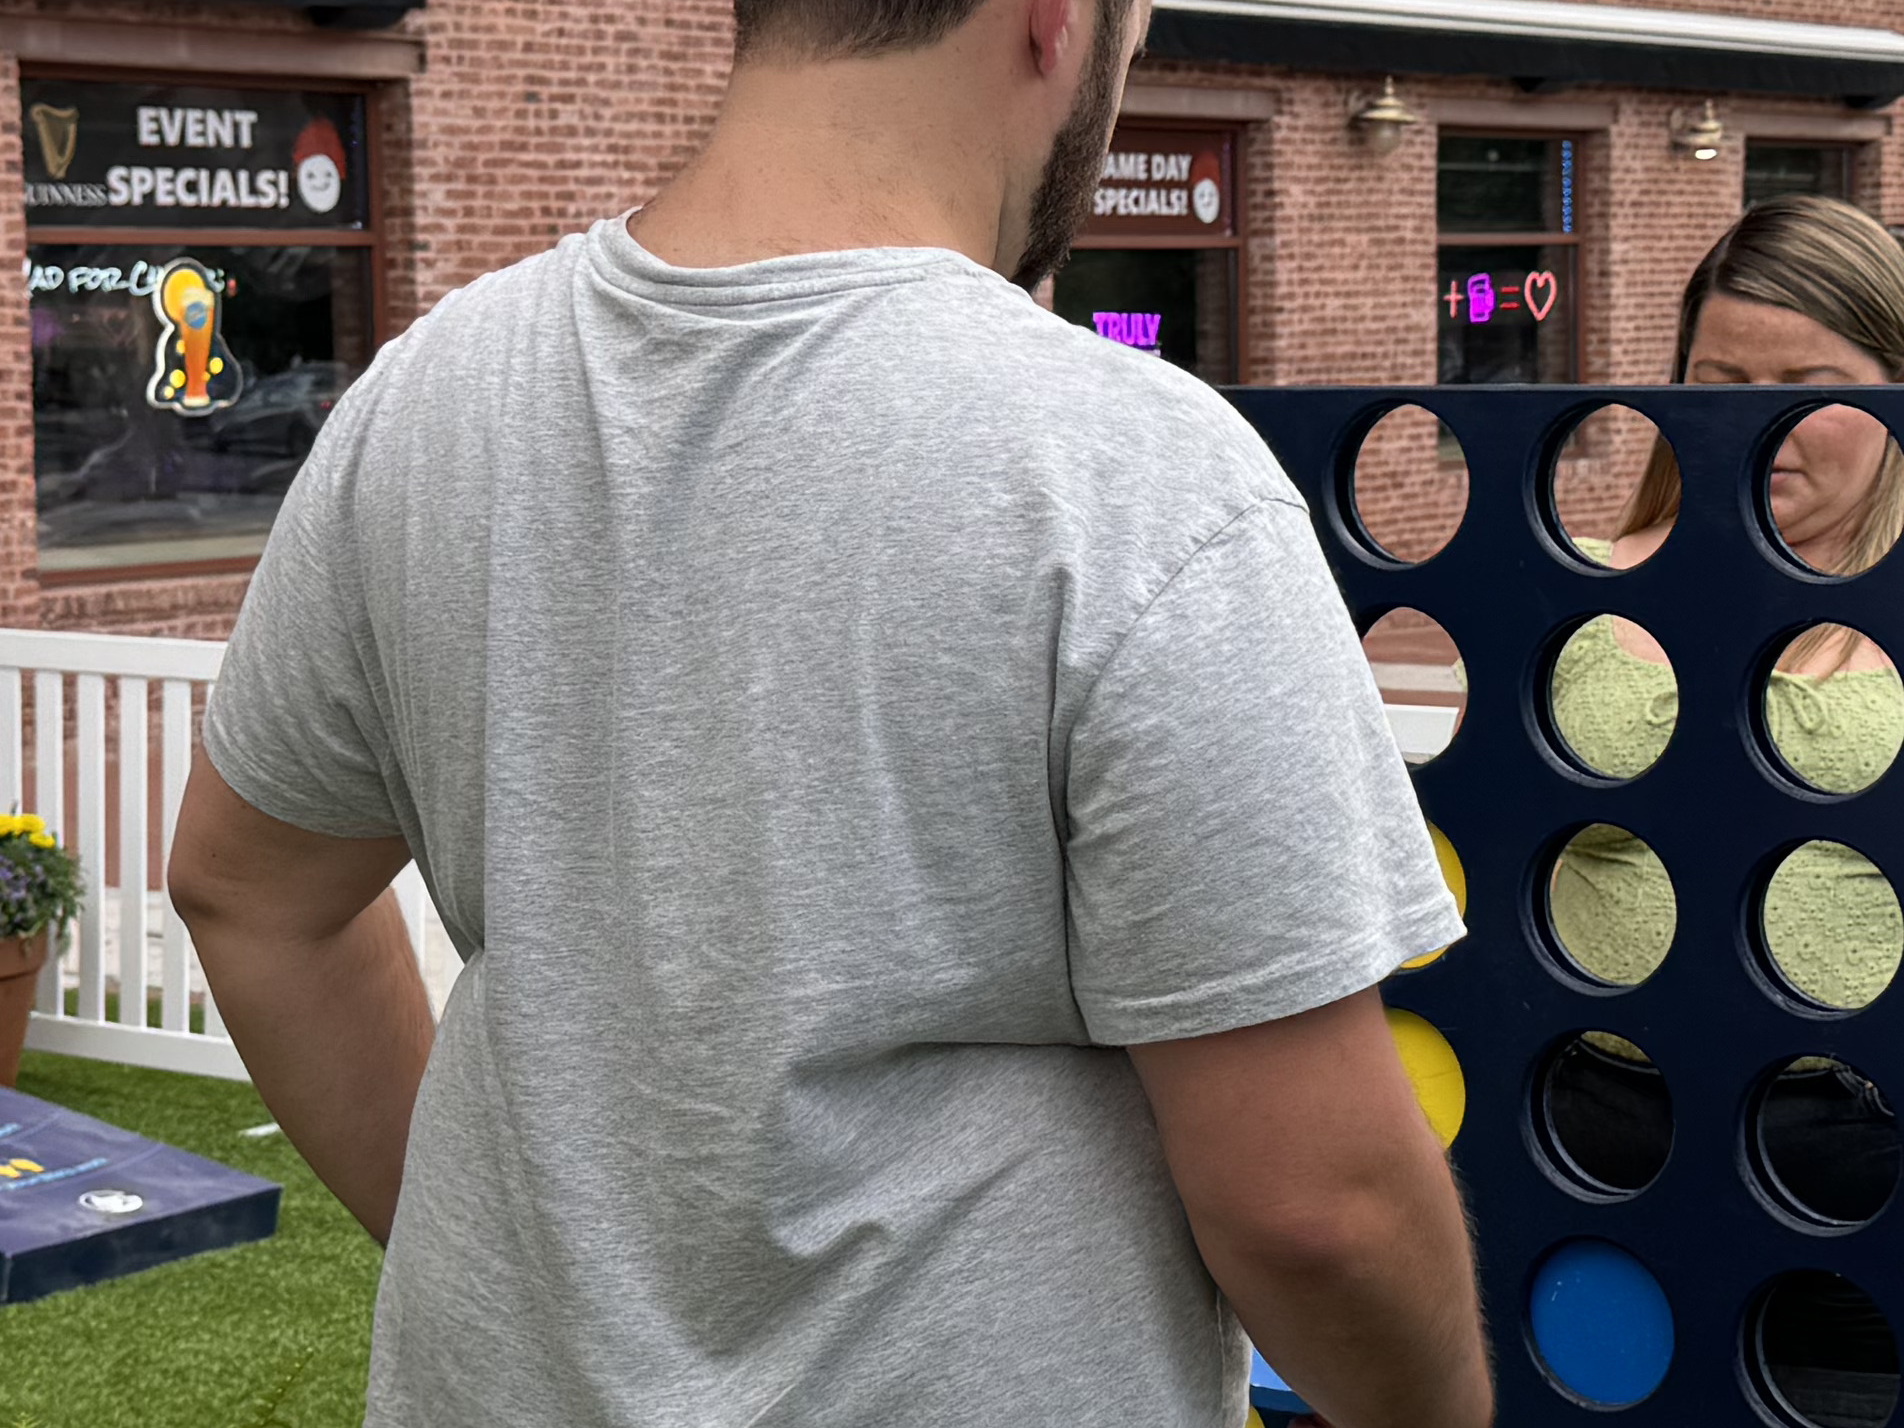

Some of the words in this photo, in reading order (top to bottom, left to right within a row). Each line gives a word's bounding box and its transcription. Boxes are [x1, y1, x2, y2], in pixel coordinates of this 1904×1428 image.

[137, 105, 258, 149] EVENT
[1101, 153, 1148, 179] AME
[1151, 154, 1192, 181] DAY
[25, 182, 108, 207] UINNESS
[106, 165, 290, 209] SPECIALS!
[1094, 187, 1188, 217] SPECIALS!
[1093, 311, 1162, 347] TRULY
